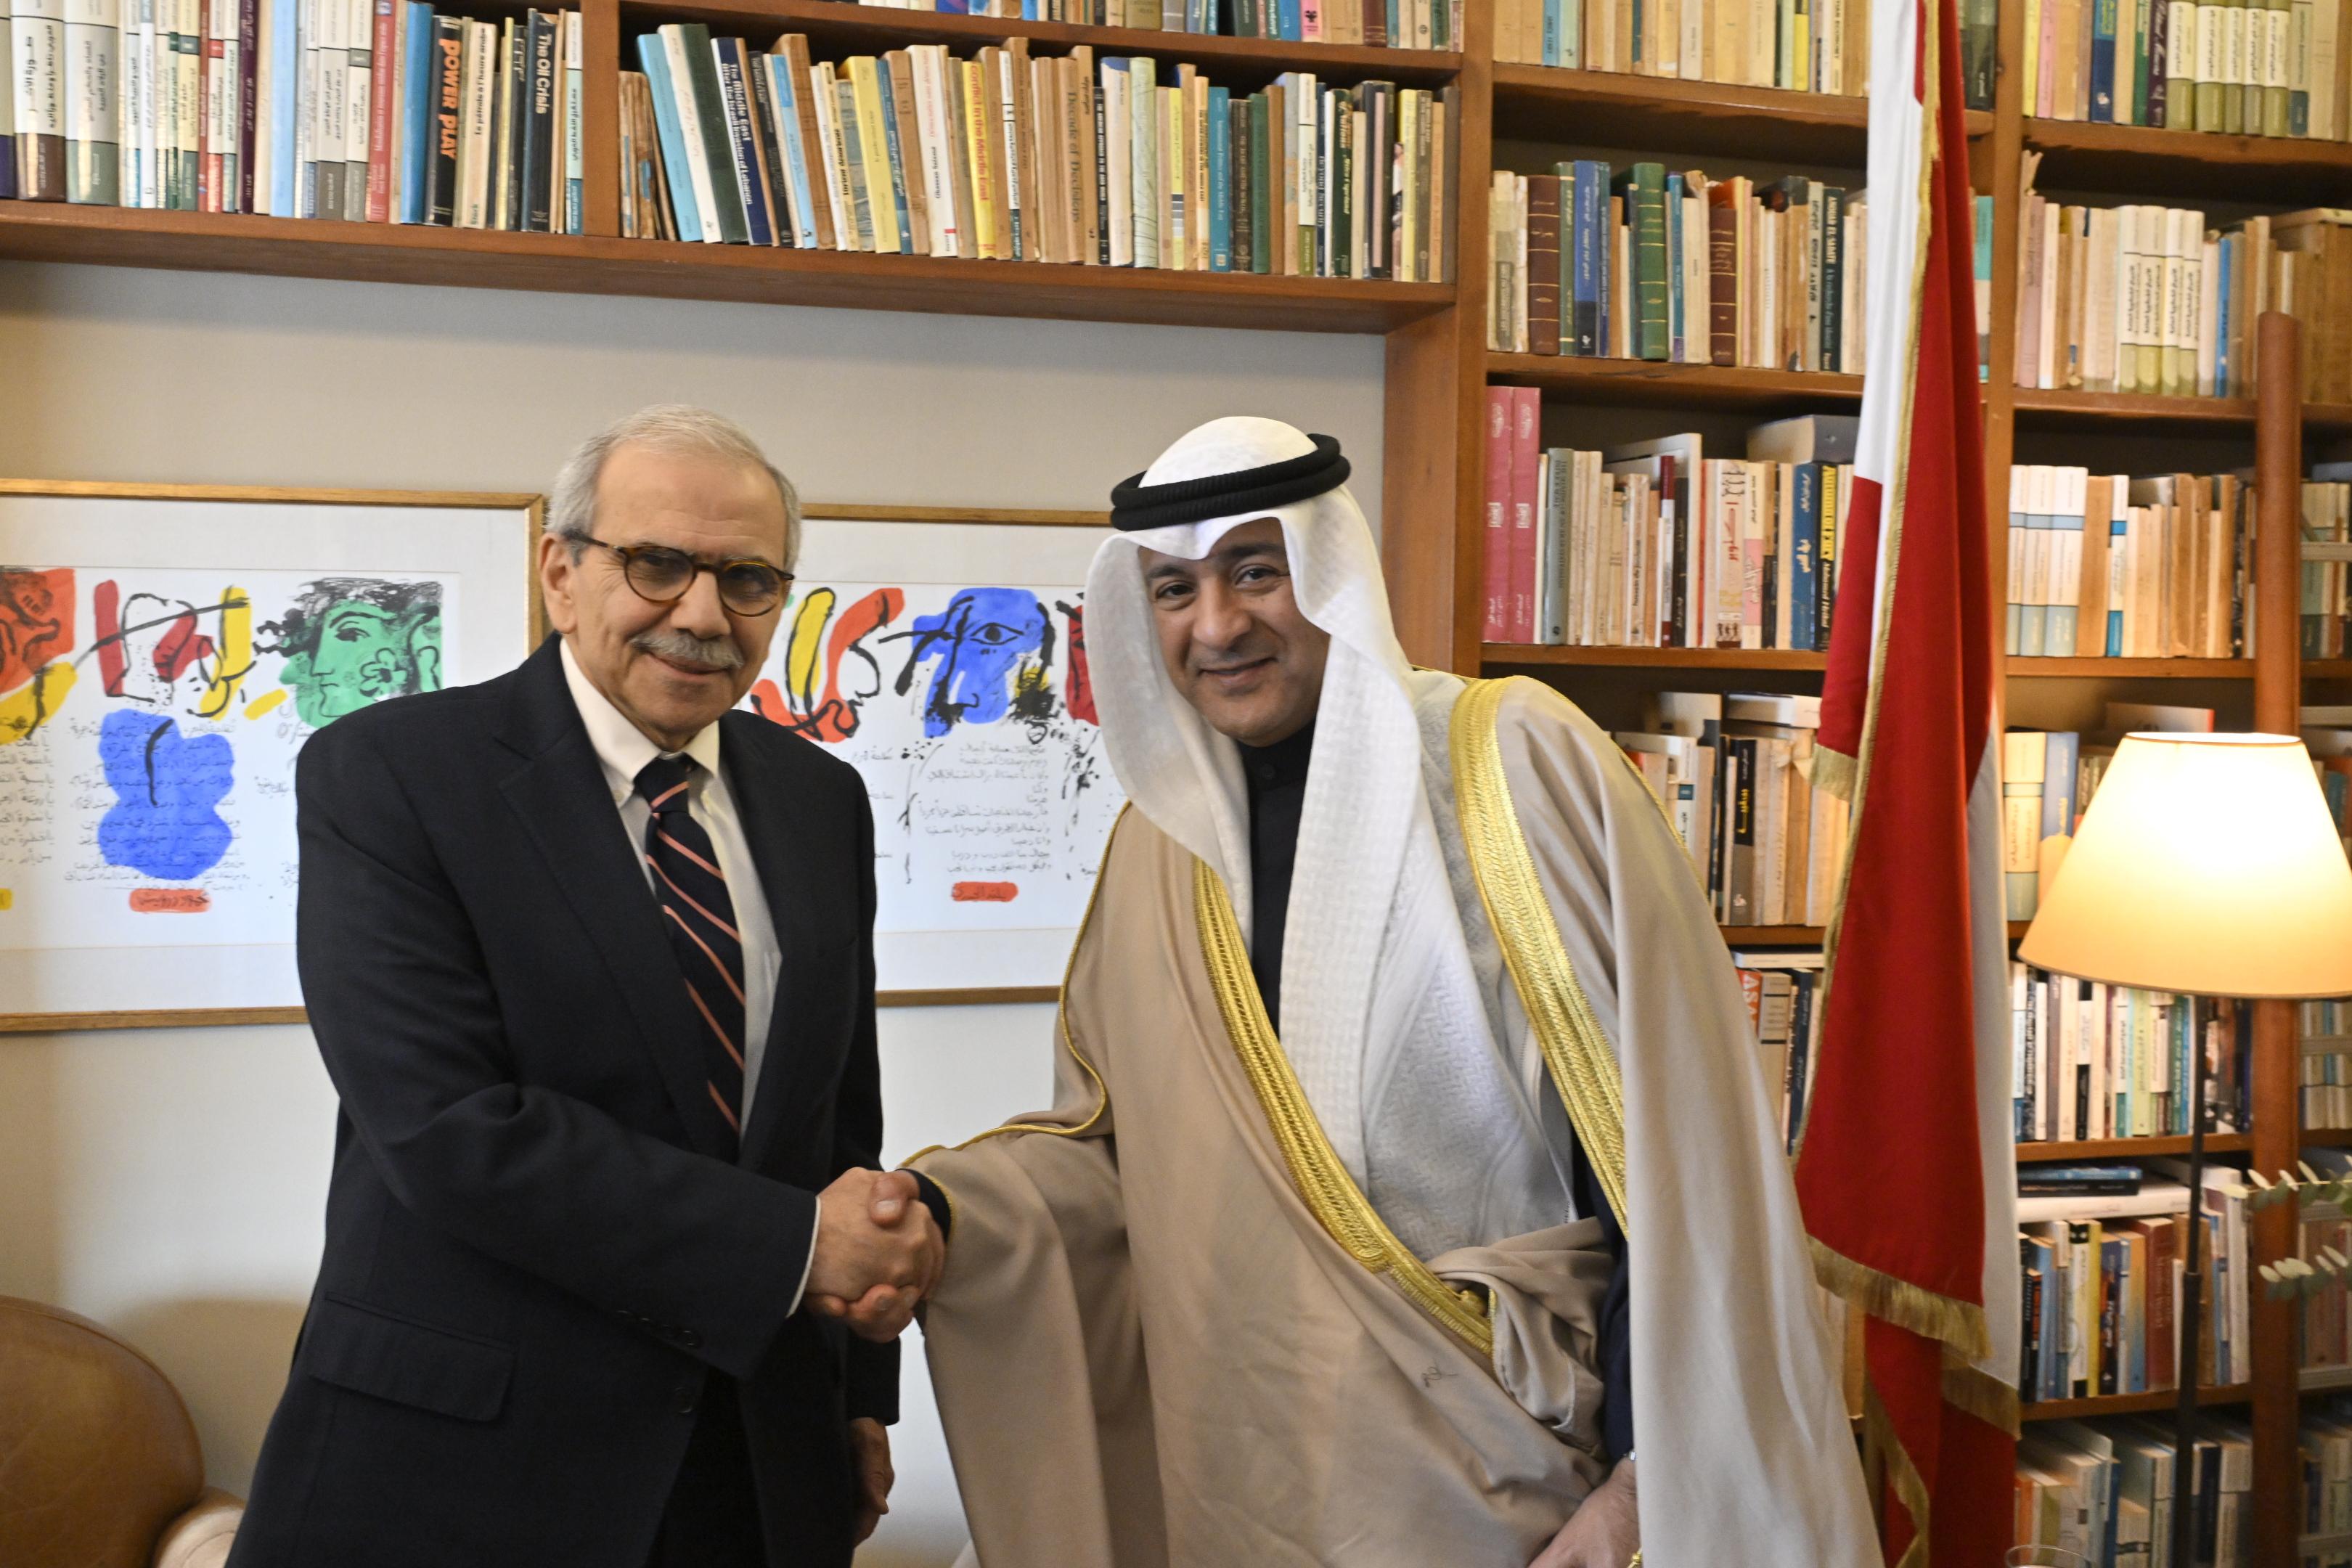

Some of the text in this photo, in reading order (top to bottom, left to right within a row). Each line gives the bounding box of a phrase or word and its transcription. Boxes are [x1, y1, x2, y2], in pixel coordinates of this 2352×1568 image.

[438, 38, 462, 160] POWER PLAY
[535, 33, 552, 114] The Oil Crisis
[733, 81, 746, 116] Middle
[740, 118, 752, 142] East
[973, 107, 982, 118] in
[974, 119, 984, 137] the
[732, 126, 744, 160] Invasion
[741, 169, 753, 205] Lebanon
[975, 139, 987, 176] Middle
[1067, 91, 1082, 223] Decade of Decisions
[979, 177, 989, 201] East
